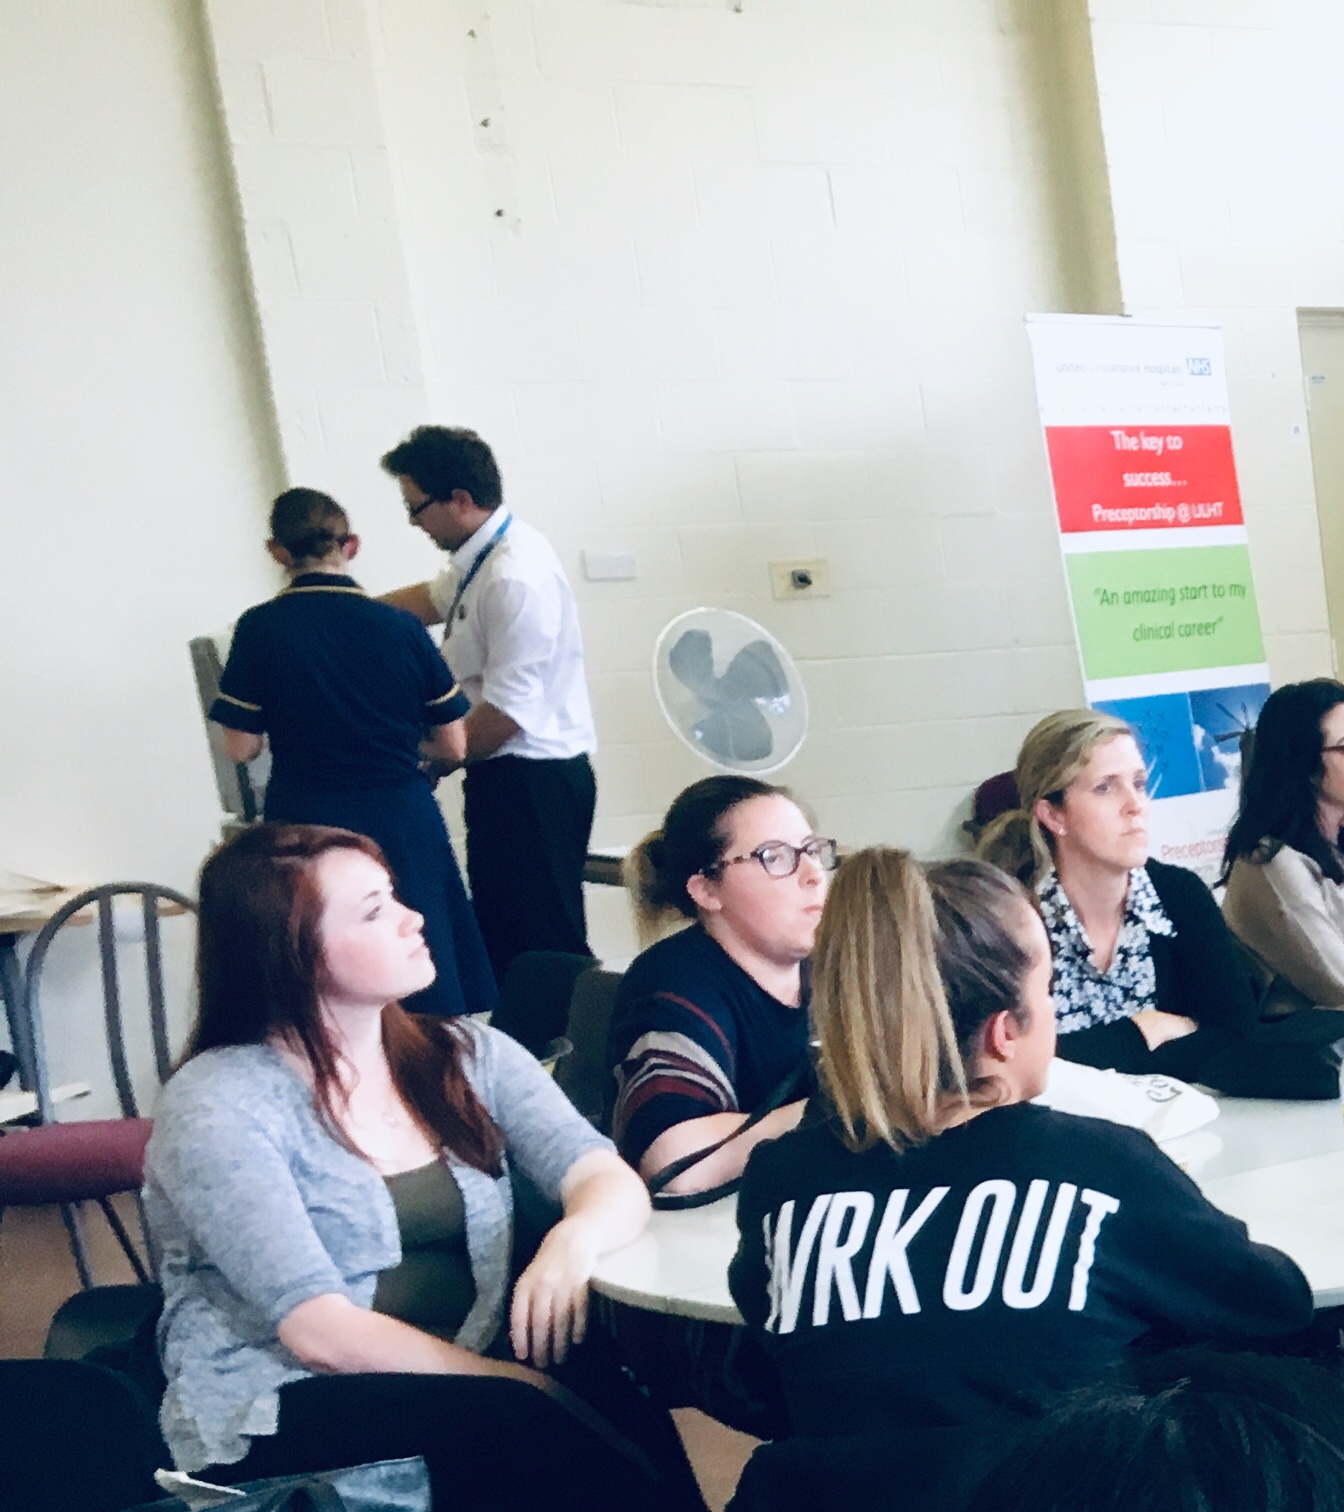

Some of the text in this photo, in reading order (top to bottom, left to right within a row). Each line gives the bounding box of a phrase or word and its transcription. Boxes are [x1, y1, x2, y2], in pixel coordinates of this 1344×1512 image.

[1187, 358, 1211, 376] NHS
[1110, 430, 1183, 456] The key to
[1091, 501, 1176, 526] Preceptorship
[1123, 584, 1176, 607] amazing
[1179, 583, 1209, 601] start
[1212, 583, 1226, 599] to
[1229, 583, 1247, 599] my
[1132, 620, 1175, 642] clinical
[942, 1178, 1121, 1312] OUT
